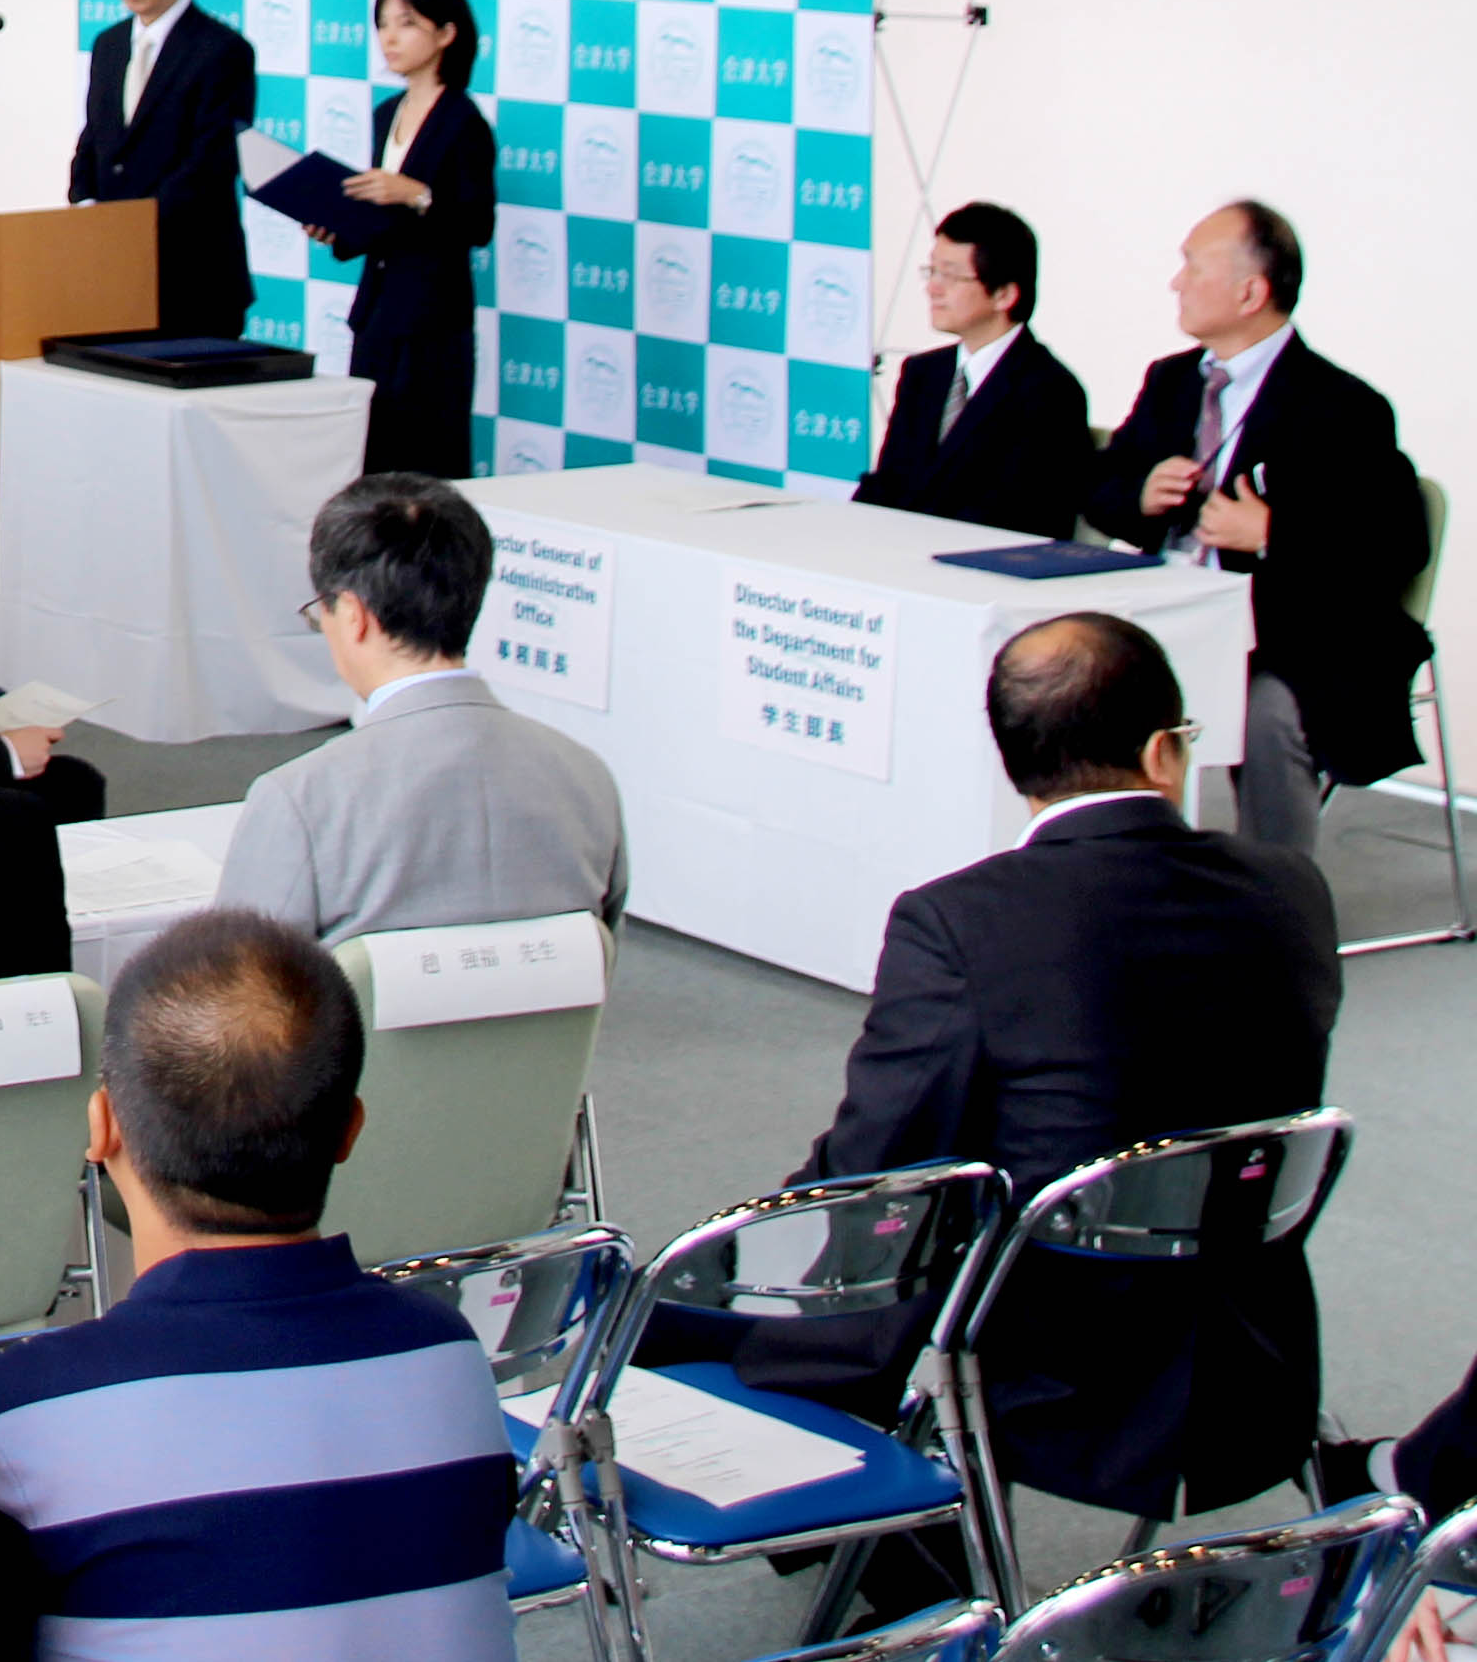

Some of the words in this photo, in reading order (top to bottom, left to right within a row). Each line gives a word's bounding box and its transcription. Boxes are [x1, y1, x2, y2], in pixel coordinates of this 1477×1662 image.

[531, 540, 585, 568] General
[588, 552, 603, 570] of
[498, 565, 598, 605] Administrative
[513, 601, 555, 627] Office
[735, 583, 796, 615] Director
[801, 598, 863, 630] General
[867, 614, 884, 633] of
[734, 620, 758, 640] the
[762, 624, 856, 664] Department
[859, 646, 881, 669] for
[747, 655, 809, 688] Student
[812, 671, 865, 702] Affairs
[761, 704, 845, 746] 学生部長
